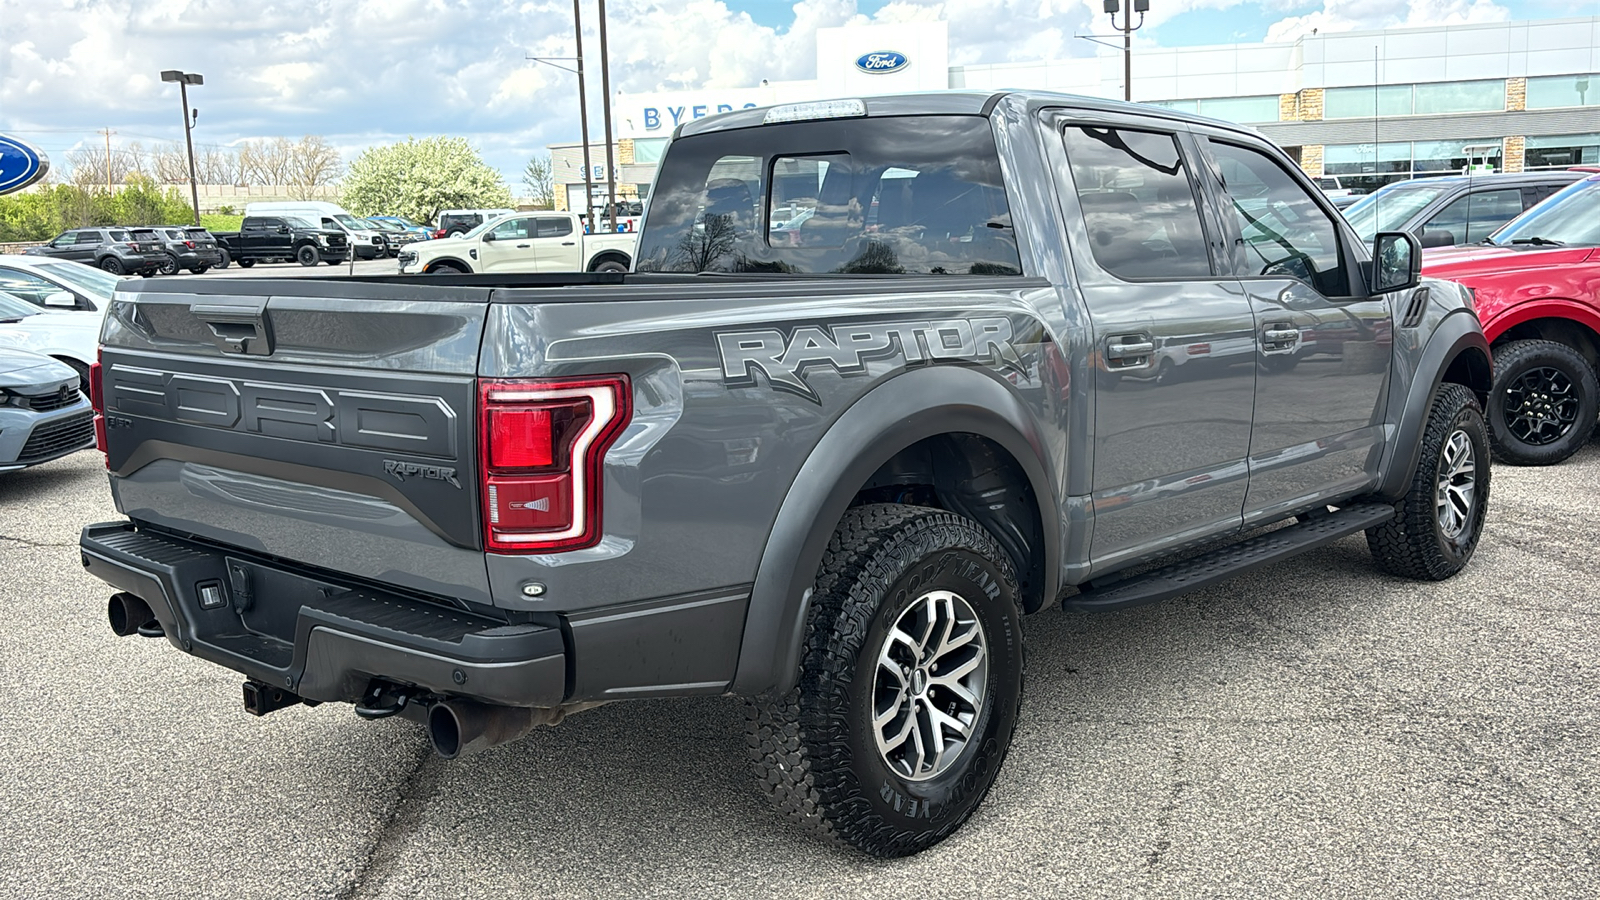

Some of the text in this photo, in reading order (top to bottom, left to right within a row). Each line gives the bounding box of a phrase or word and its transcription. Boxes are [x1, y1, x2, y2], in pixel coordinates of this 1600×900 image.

[865, 53, 898, 69] Ford
[644, 103, 757, 128] BYE
[714, 316, 1030, 402] RAPTOR
[107, 363, 458, 461] FORD
[383, 459, 463, 490] RAPTOR
